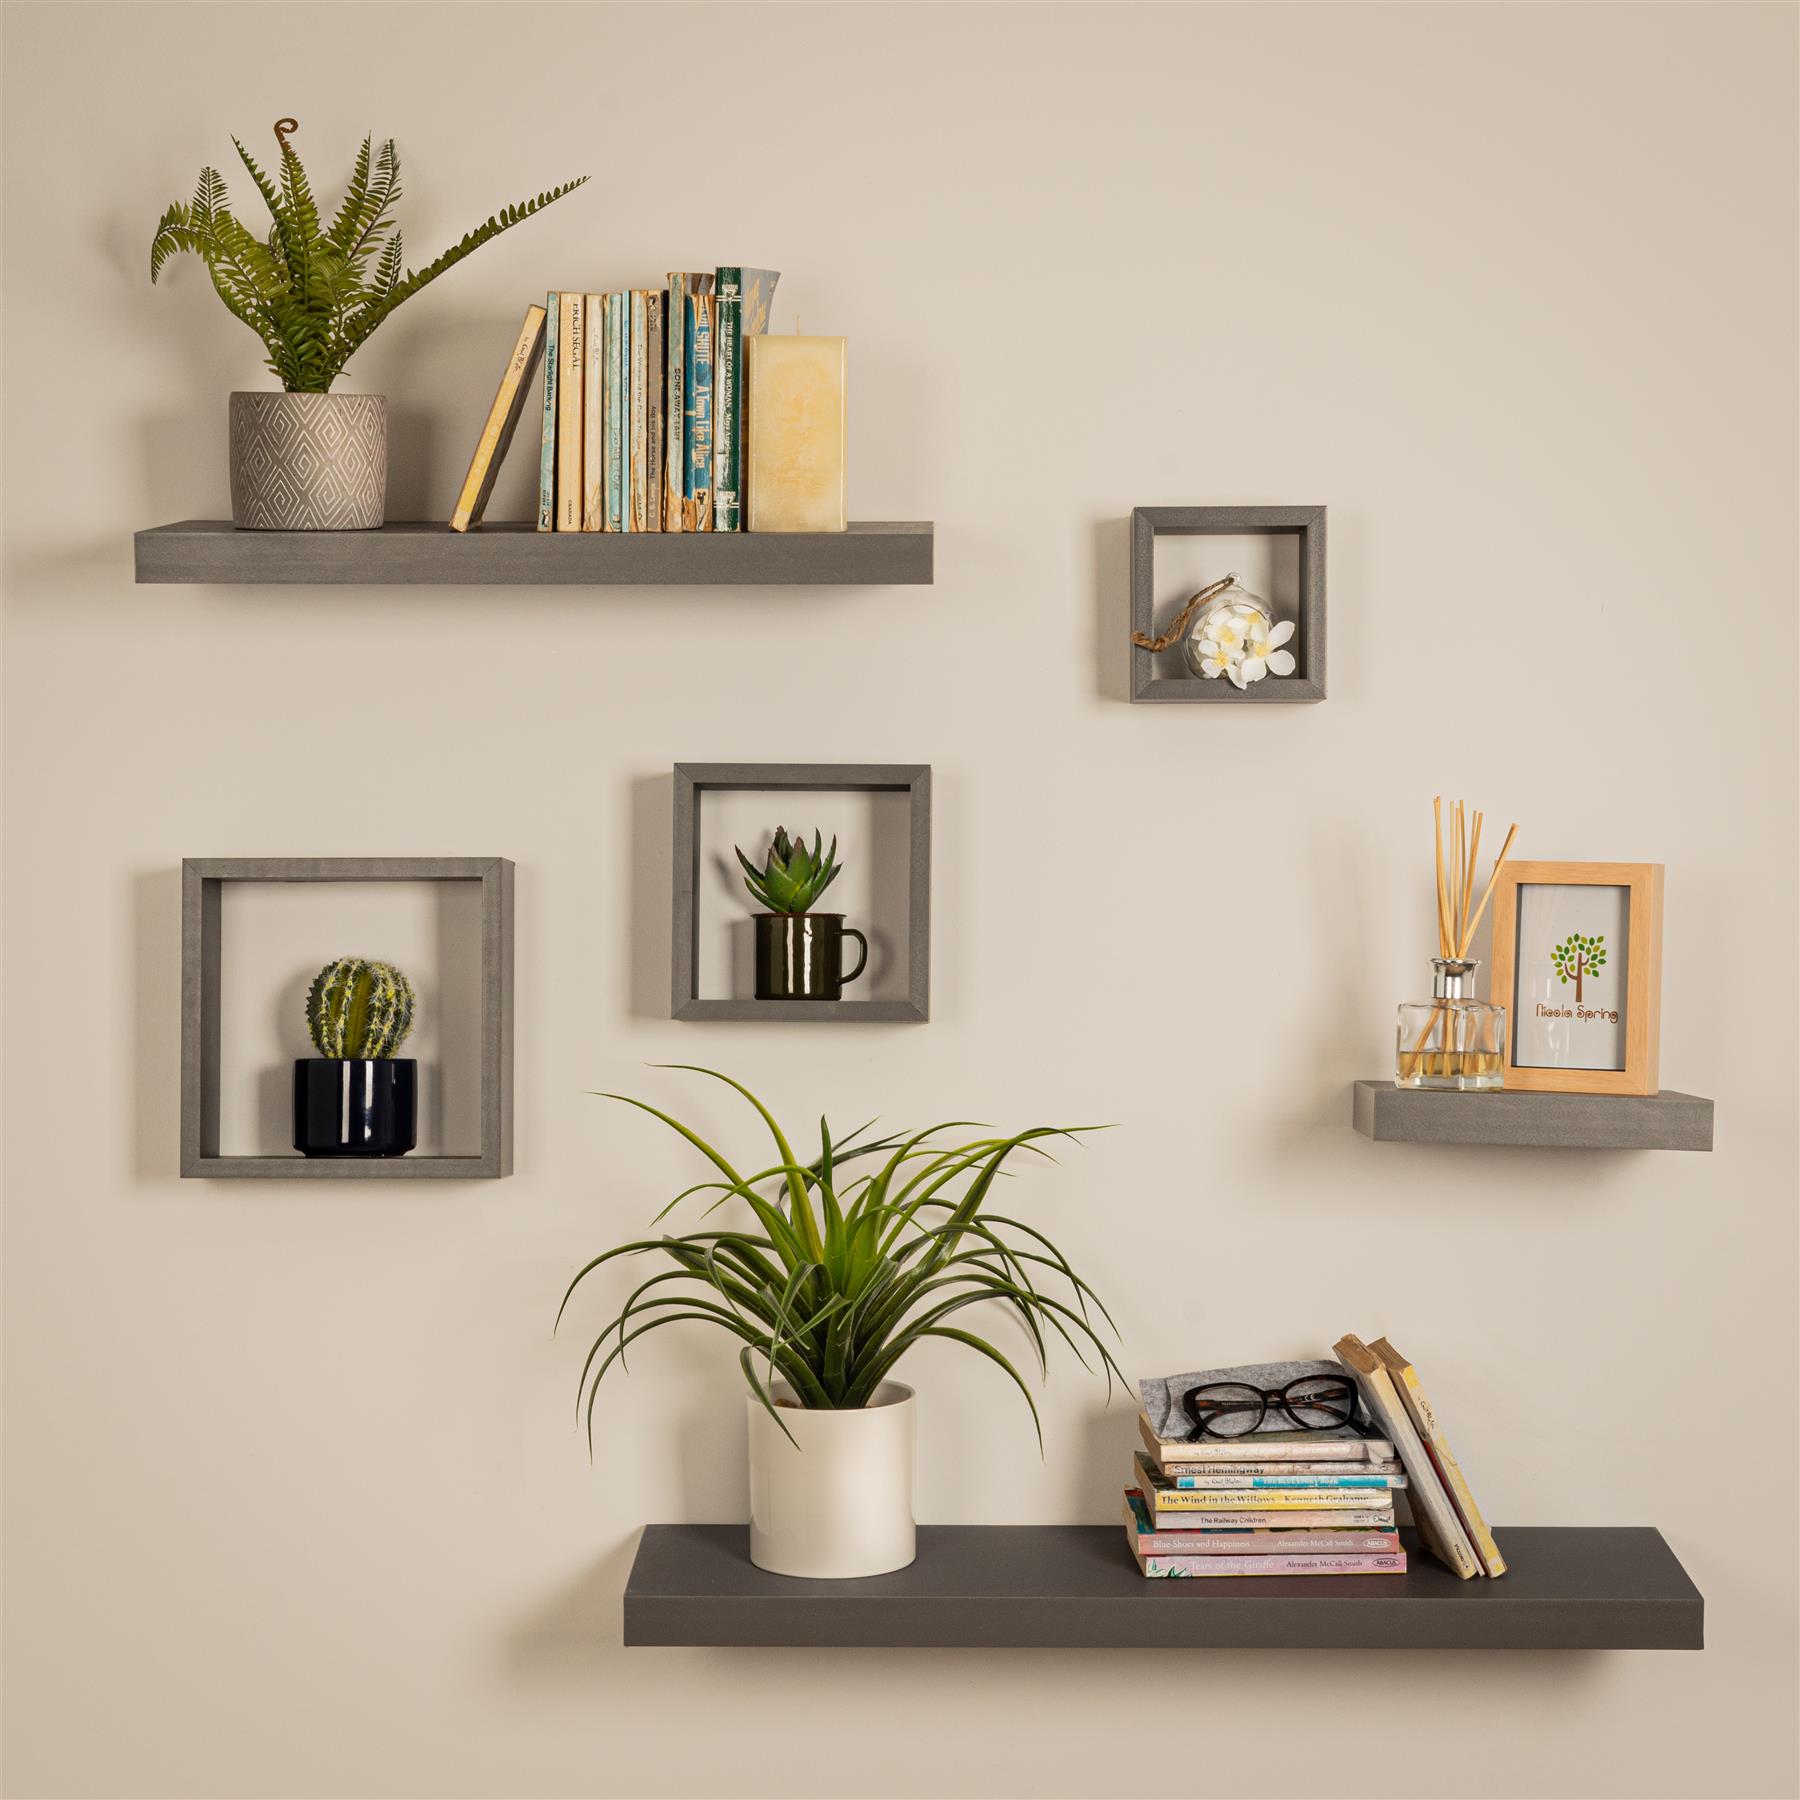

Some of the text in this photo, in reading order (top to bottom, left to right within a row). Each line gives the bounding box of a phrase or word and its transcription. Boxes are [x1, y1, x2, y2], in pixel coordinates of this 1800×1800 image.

[572, 303, 581, 370] ERICH SEGAL
[695, 331, 710, 365] SHUTE
[726, 361, 733, 371] OF
[695, 385, 709, 393] A
[695, 395, 710, 418] Town
[695, 420, 710, 442] Like
[695, 443, 709, 468] Alice
[1536, 1003, 1618, 1024] Nicola Spring
[1174, 1465, 1207, 1474] Ernest
[1208, 1465, 1265, 1475] Hemingway
[1162, 1495, 1369, 1504] The Wind in the Willows Kenneth Grahame
[1153, 1540, 1171, 1548] Blue
[1172, 1540, 1194, 1548] Shoes
[1196, 1540, 1210, 1548] and
[1212, 1540, 1250, 1549] Happiness
[1277, 1539, 1309, 1547] Alexander
[1310, 1539, 1333, 1547] McCall
[1215, 1560, 1224, 1569] of
[1226, 1560, 1241, 1569] the
[1244, 1558, 1275, 1569] Giraffe
[1286, 1560, 1318, 1568] Alexander
